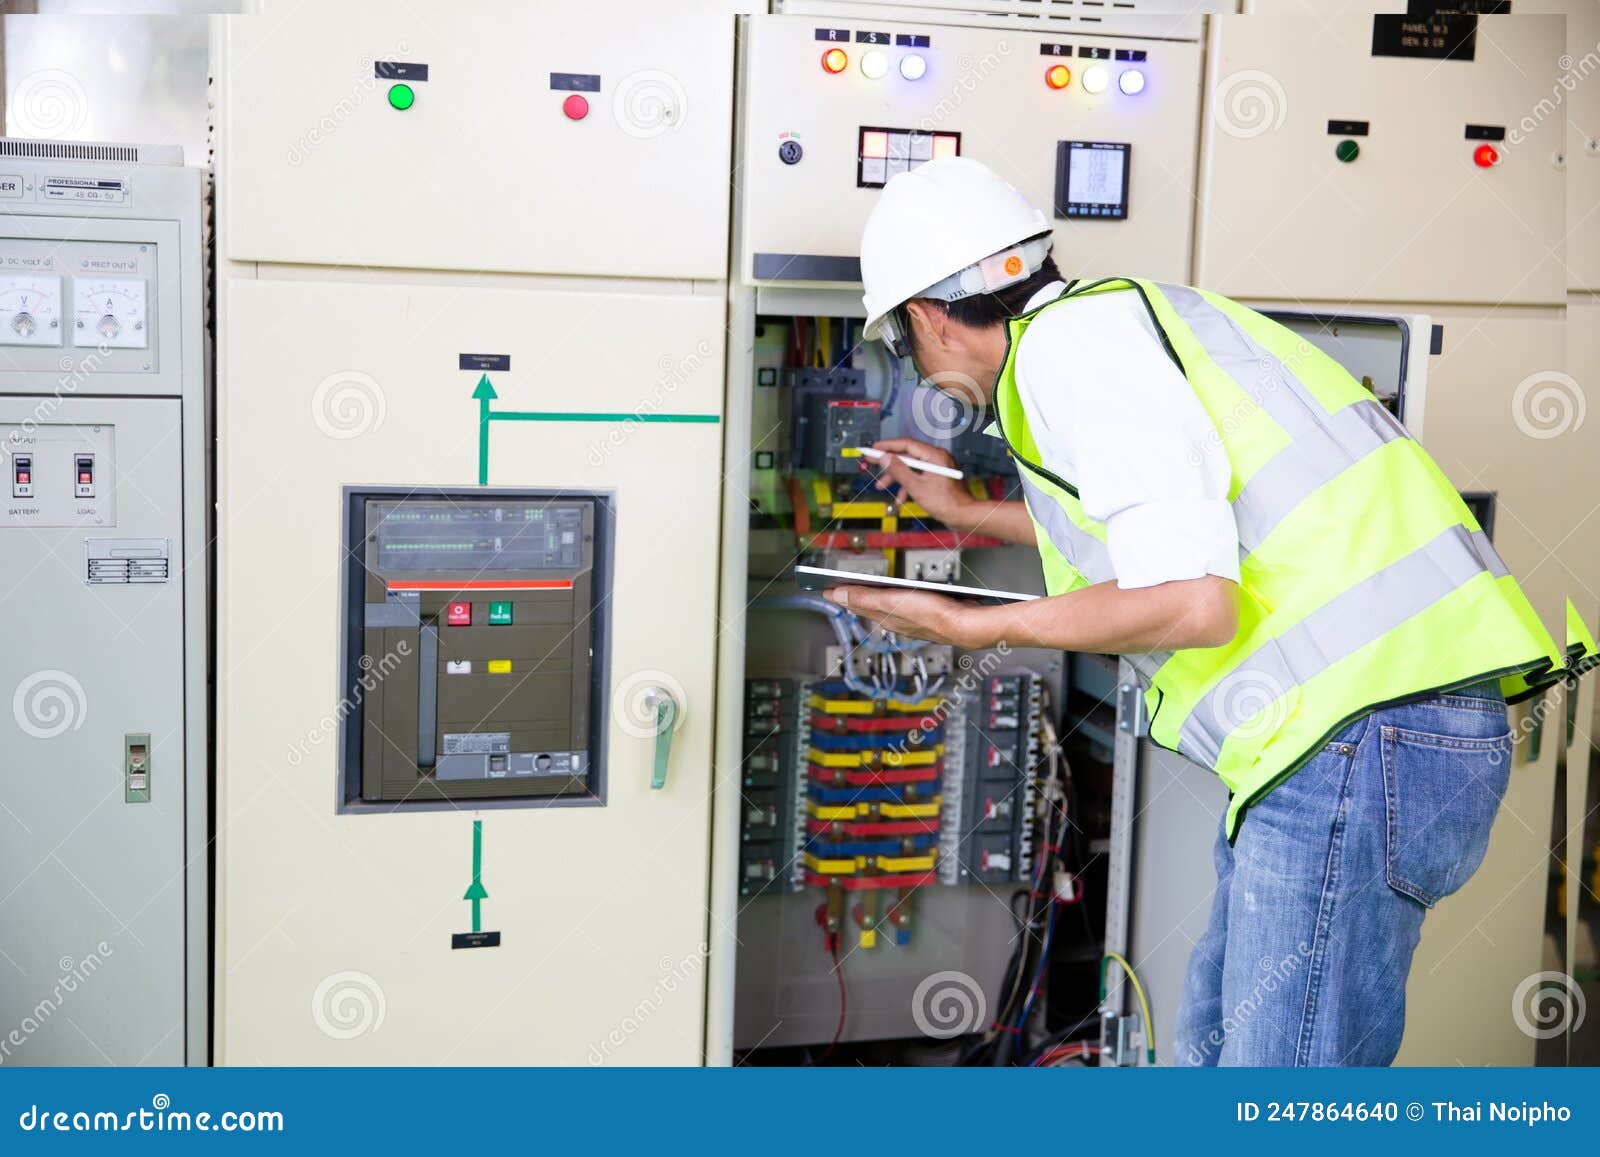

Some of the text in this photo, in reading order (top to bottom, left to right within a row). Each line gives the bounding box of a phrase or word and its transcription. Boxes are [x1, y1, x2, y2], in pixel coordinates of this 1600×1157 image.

[829, 30, 837, 40] R
[870, 33, 877, 43] S
[911, 35, 917, 46] T
[1053, 45, 1061, 55] R
[1091, 48, 1099, 58] S
[1128, 50, 1135, 60] T
[48, 178, 97, 187] PROFESSIONAL
[21, 296, 28, 304] V
[106, 298, 113, 306] A
